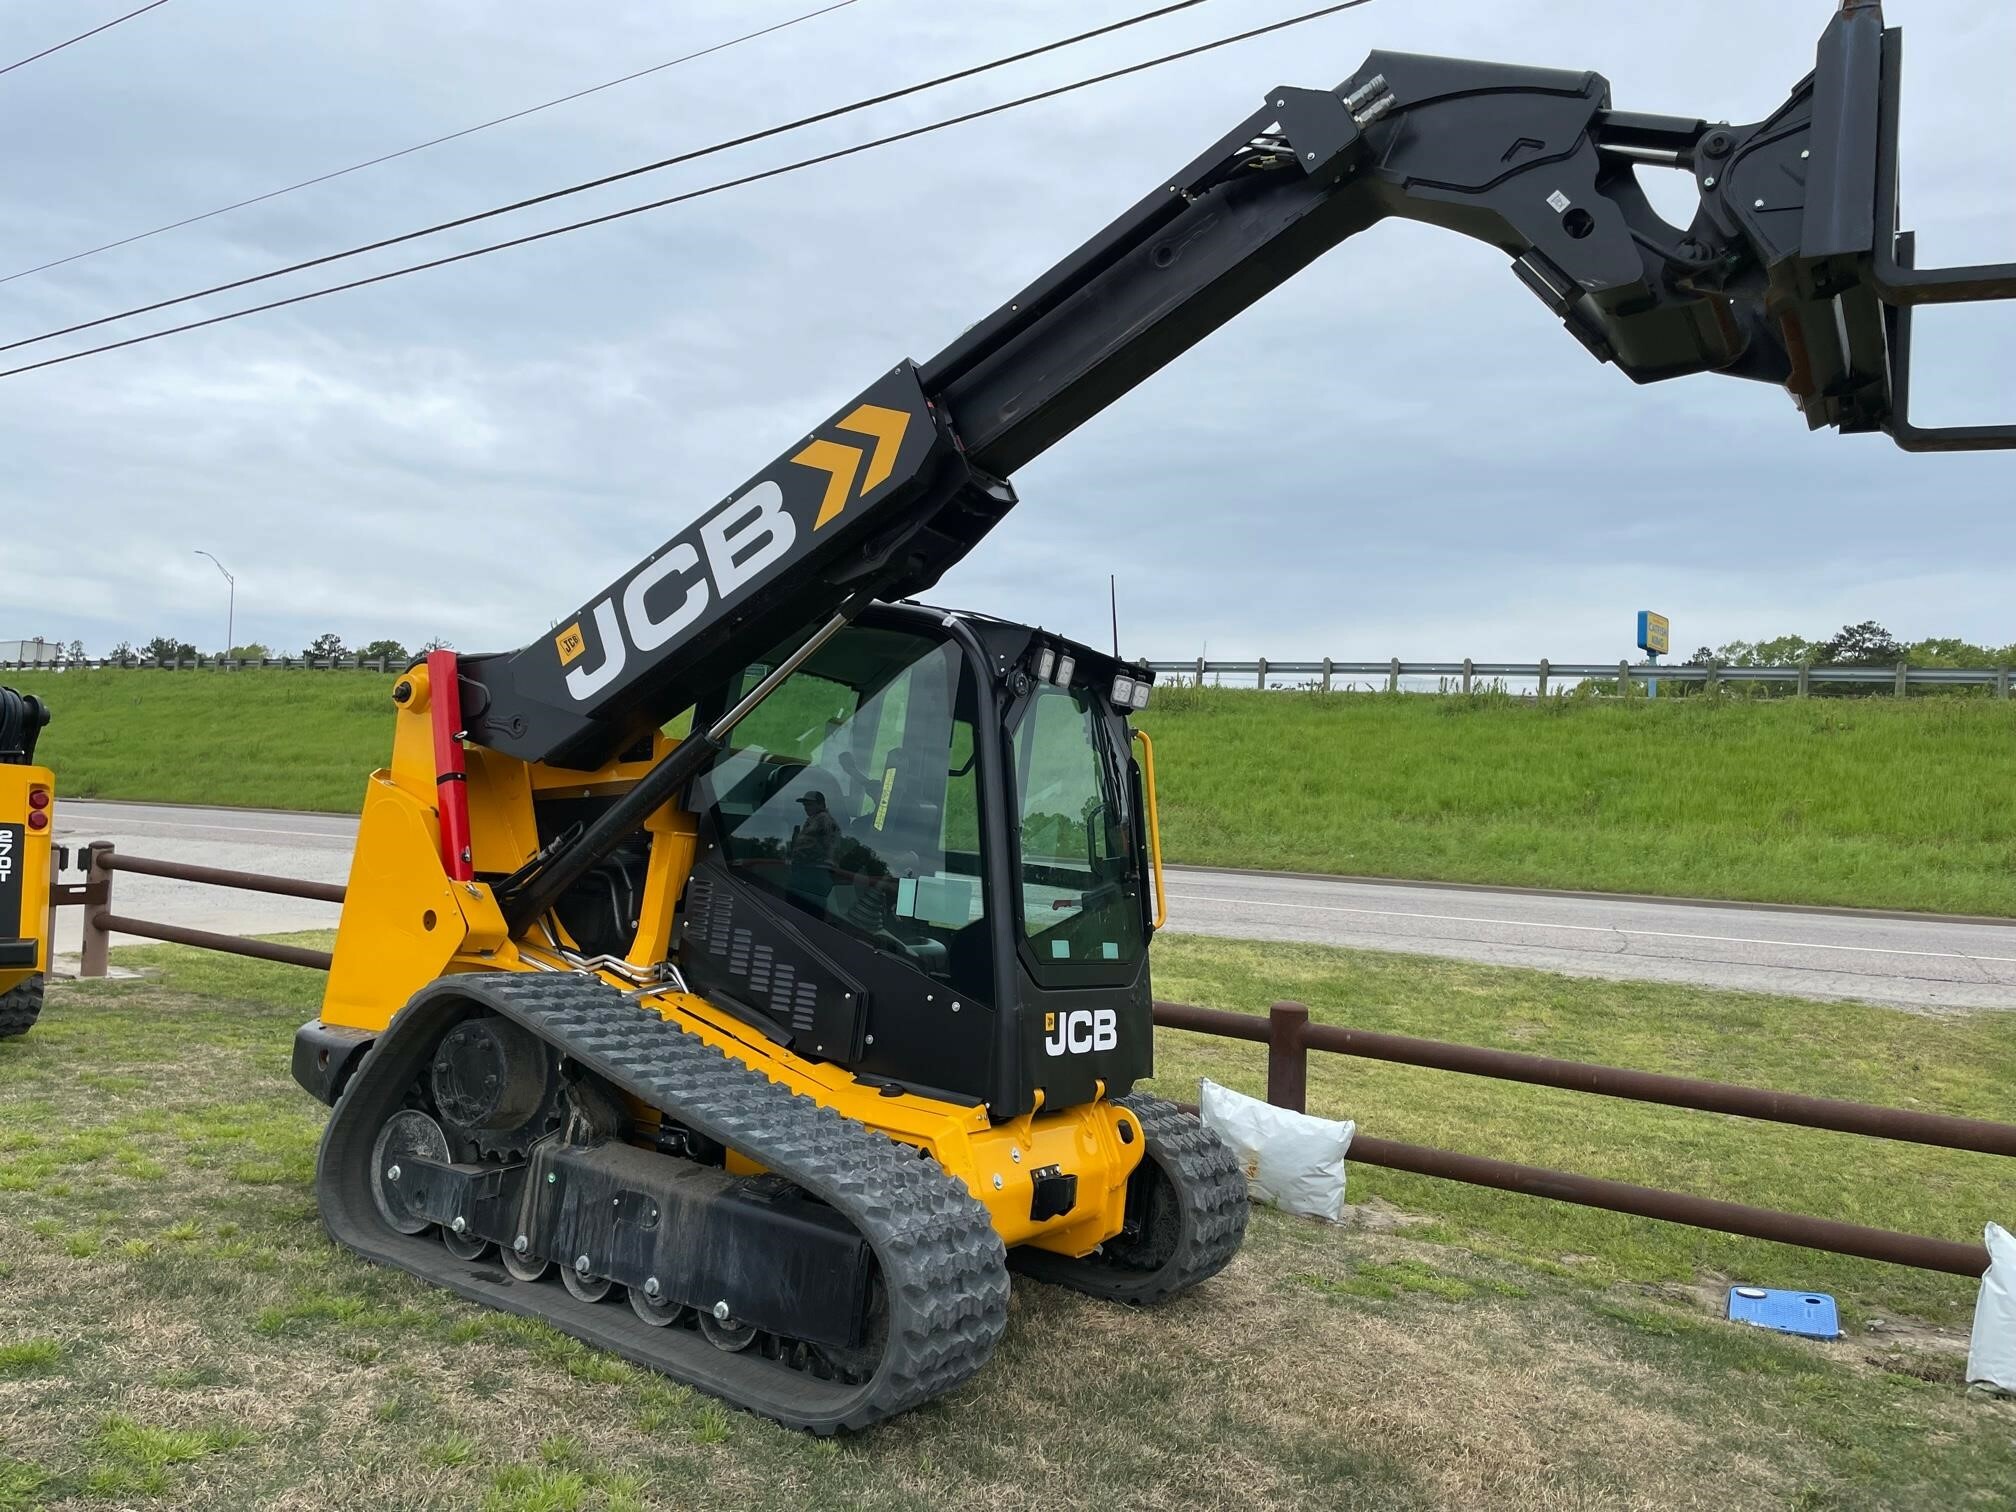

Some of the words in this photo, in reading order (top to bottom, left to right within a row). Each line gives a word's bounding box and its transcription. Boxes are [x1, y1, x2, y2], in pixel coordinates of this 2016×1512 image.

[565, 480, 797, 701] JCB
[563, 635, 579, 653] JCB
[0, 830, 13, 882] 270T
[1045, 1009, 1118, 1056] JCB
